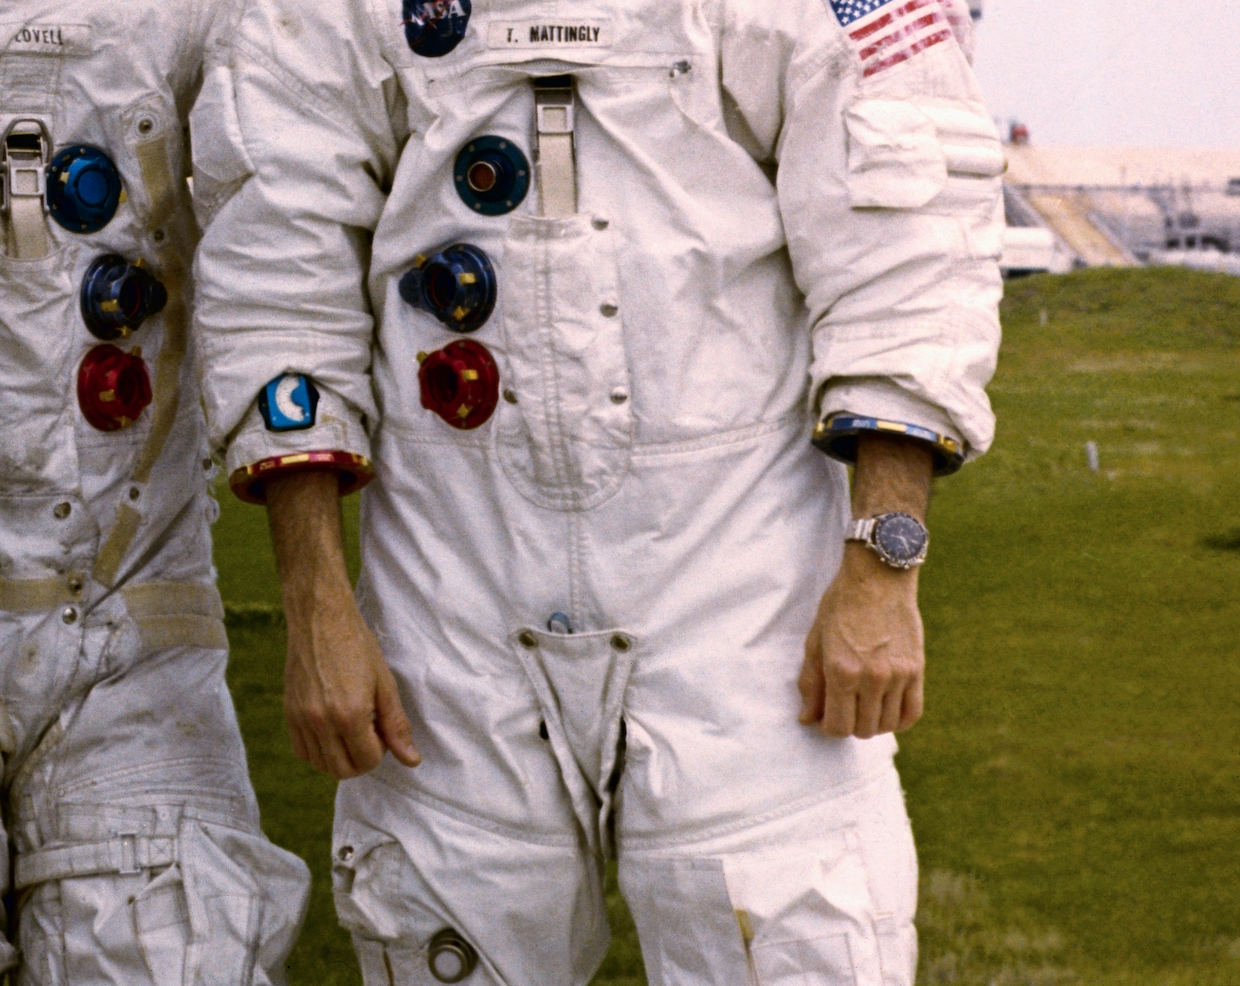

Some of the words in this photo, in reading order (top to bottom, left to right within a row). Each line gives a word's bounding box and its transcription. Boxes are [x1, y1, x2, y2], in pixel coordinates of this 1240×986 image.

[14, 28, 64, 45] LOVELL
[507, 27, 518, 43] T.
[530, 25, 600, 43] MATTINGLY
